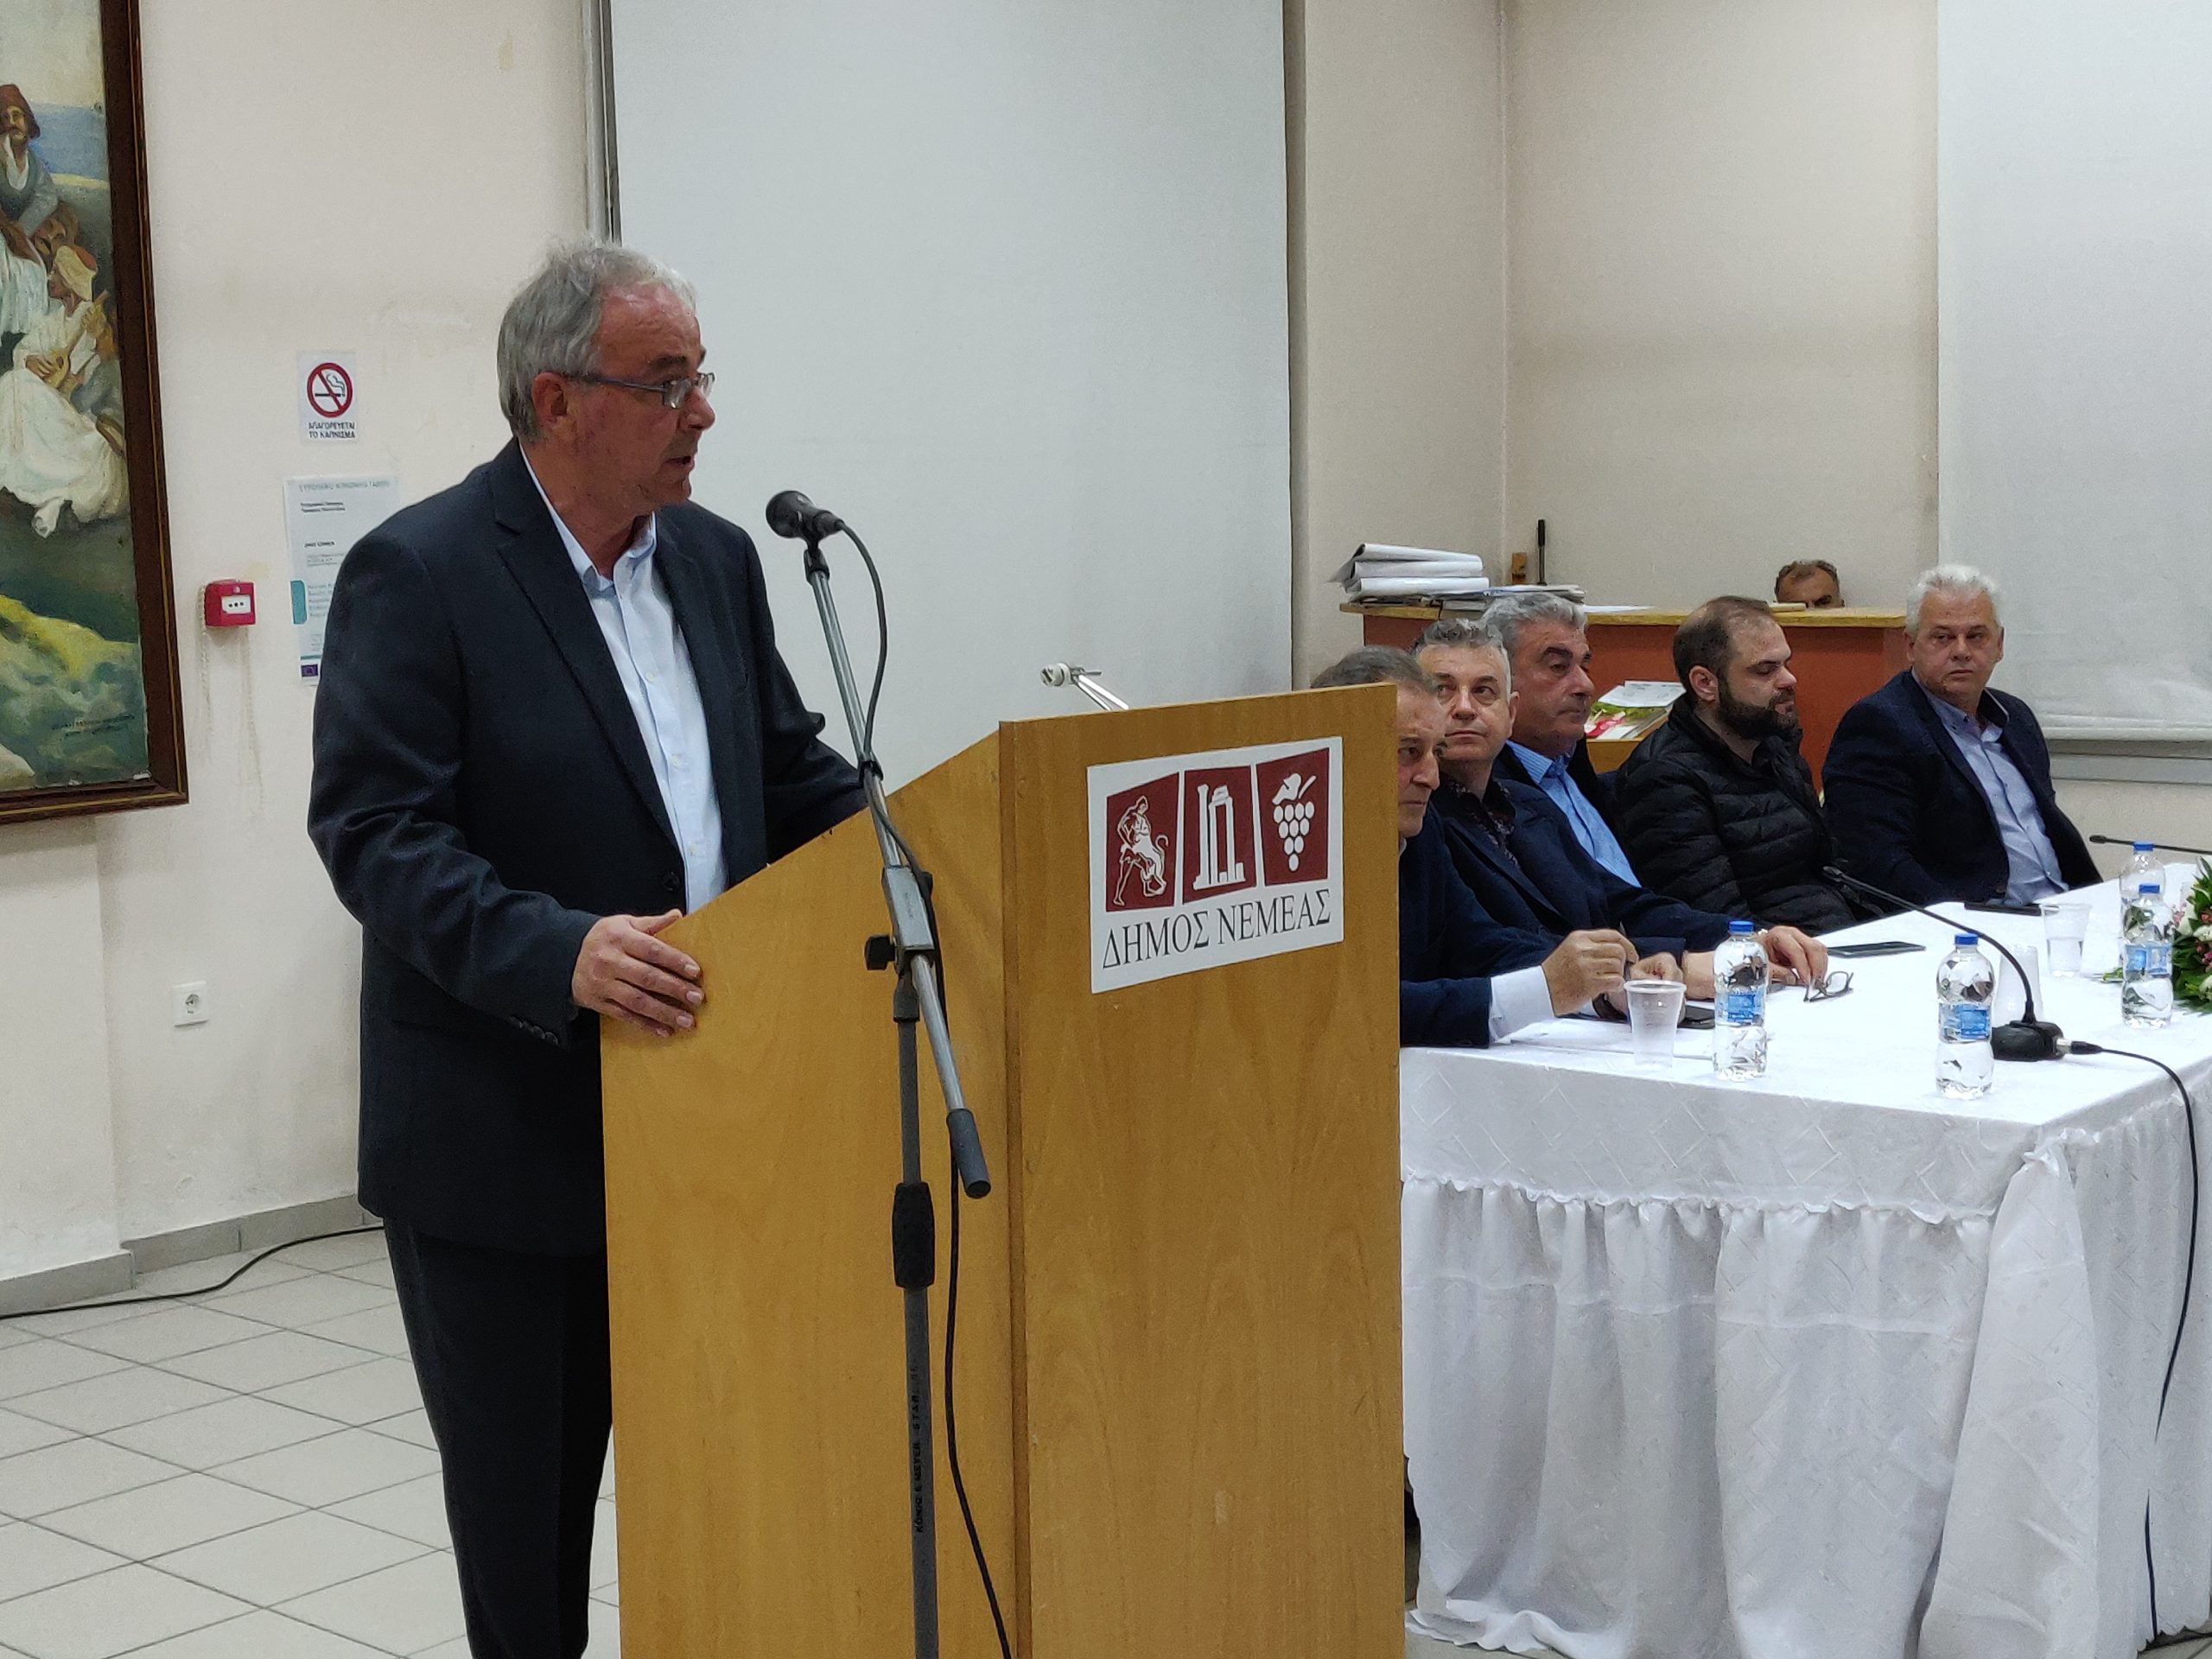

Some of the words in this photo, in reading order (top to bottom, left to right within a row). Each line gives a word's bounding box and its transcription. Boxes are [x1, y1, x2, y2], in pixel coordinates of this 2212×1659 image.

[320, 430, 356, 439] ΚΑΠΝΙΣΜΑ
[1103, 911, 1210, 969] ΔΗΜΟΣ
[1217, 888, 1332, 944] ΝΕΜΕΑΣ
